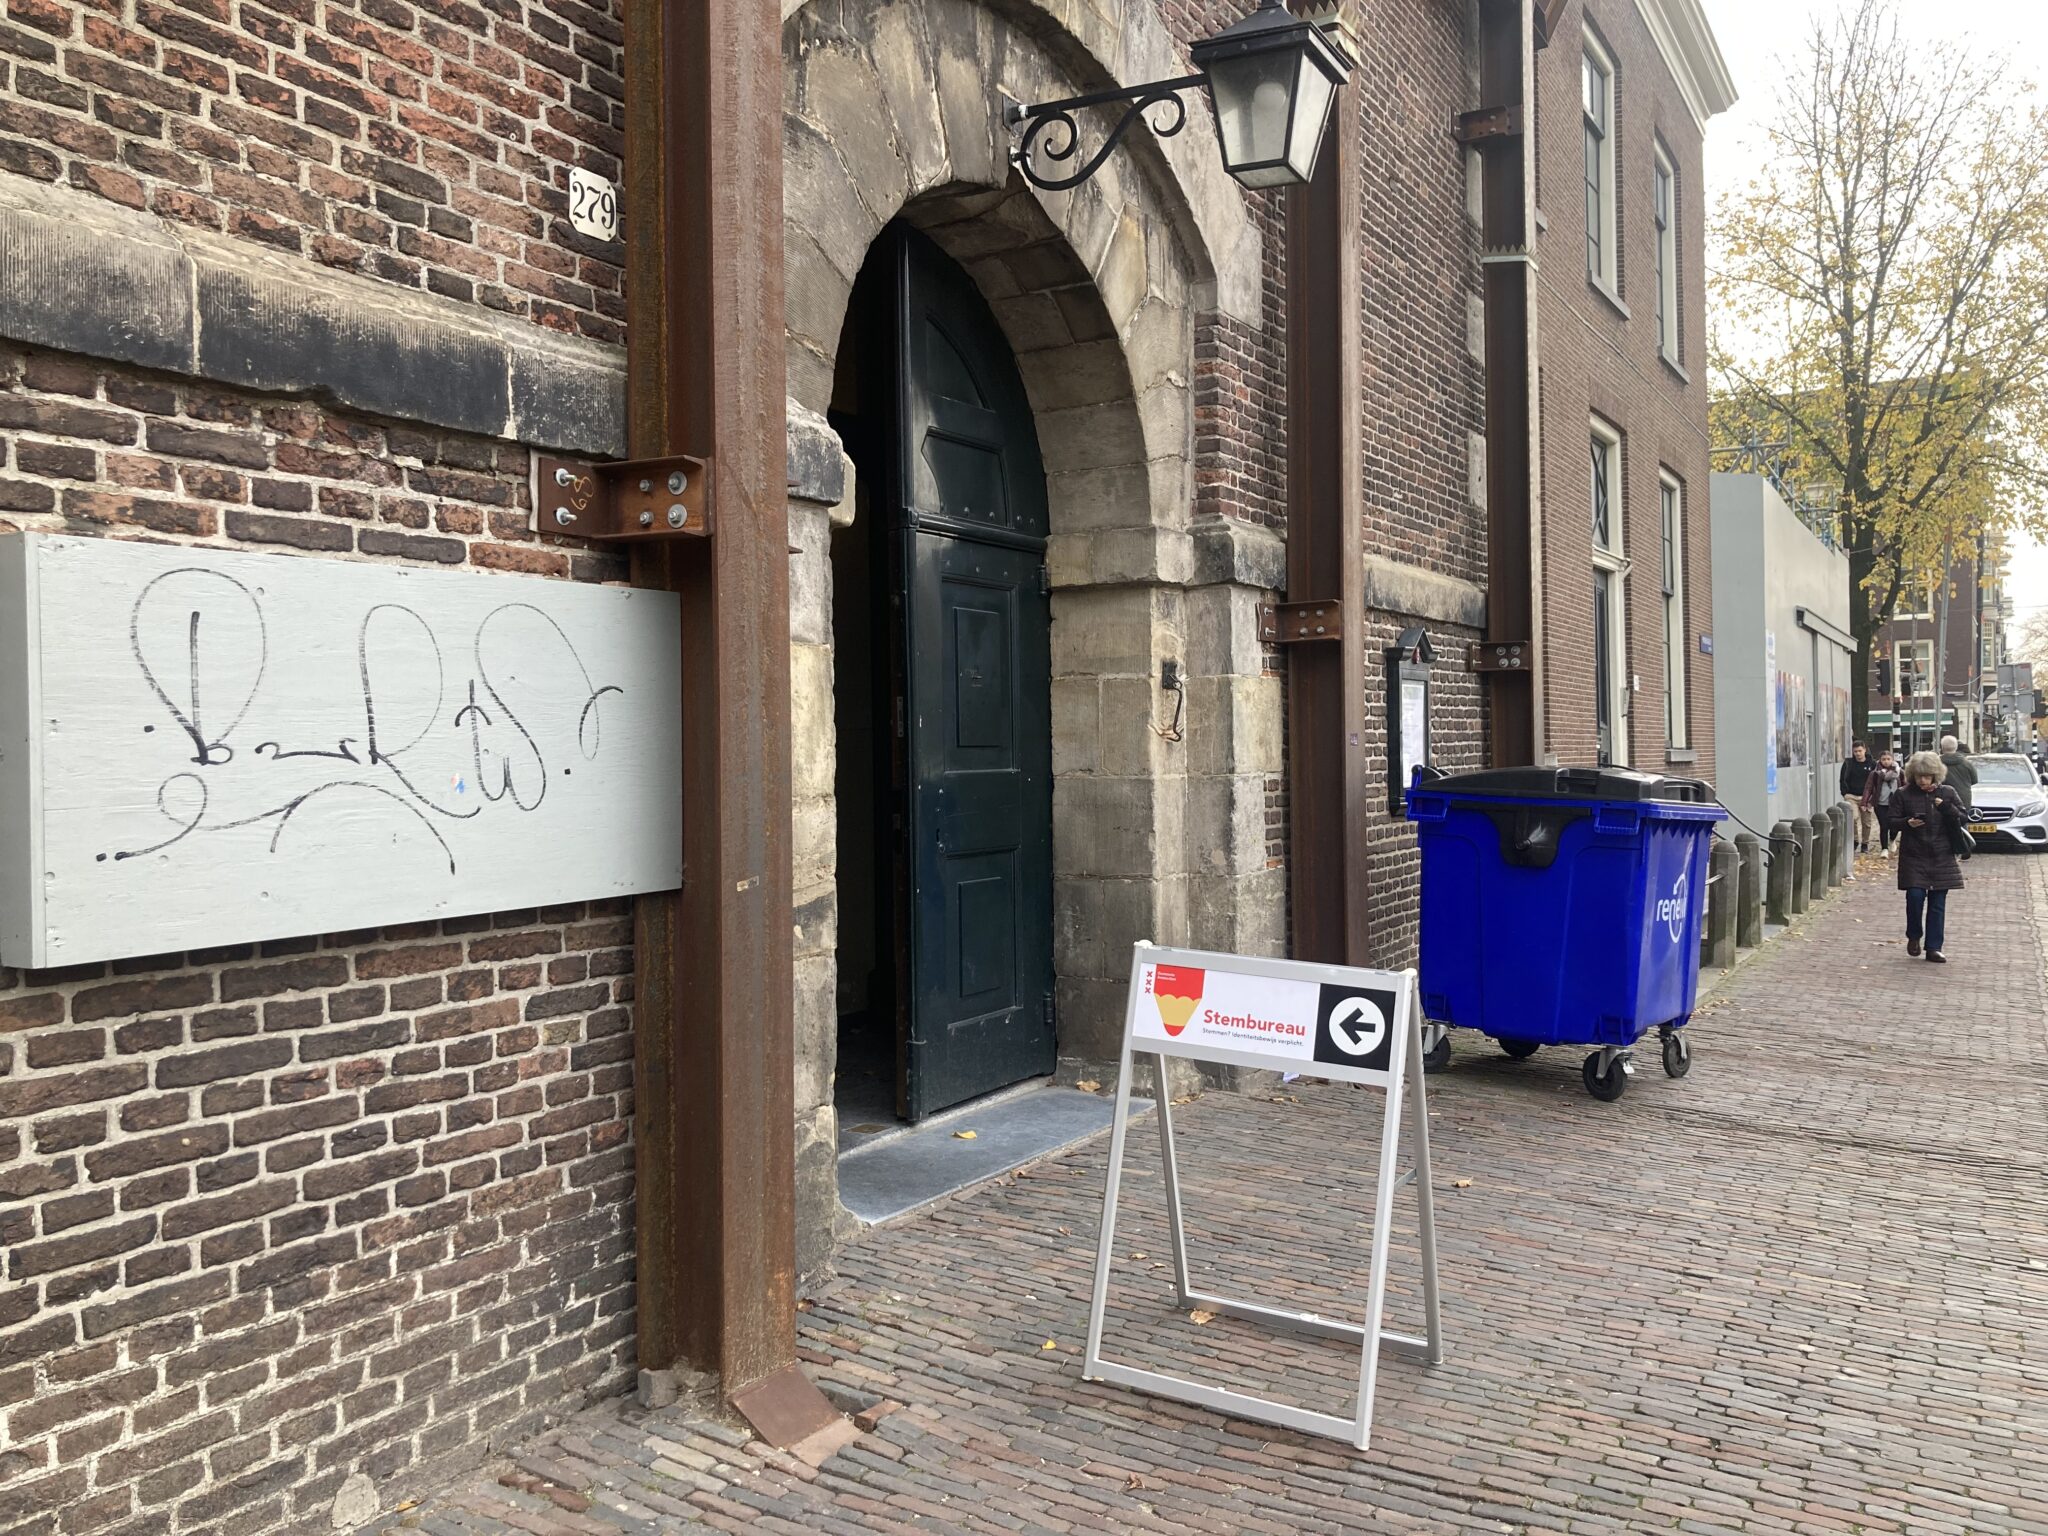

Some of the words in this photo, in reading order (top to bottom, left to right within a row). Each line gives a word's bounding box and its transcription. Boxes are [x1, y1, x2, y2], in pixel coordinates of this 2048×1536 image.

[572, 181, 615, 230] 279
[1202, 1027, 1231, 1037] Stemmen?
[1203, 1009, 1306, 1037] Stembureau
